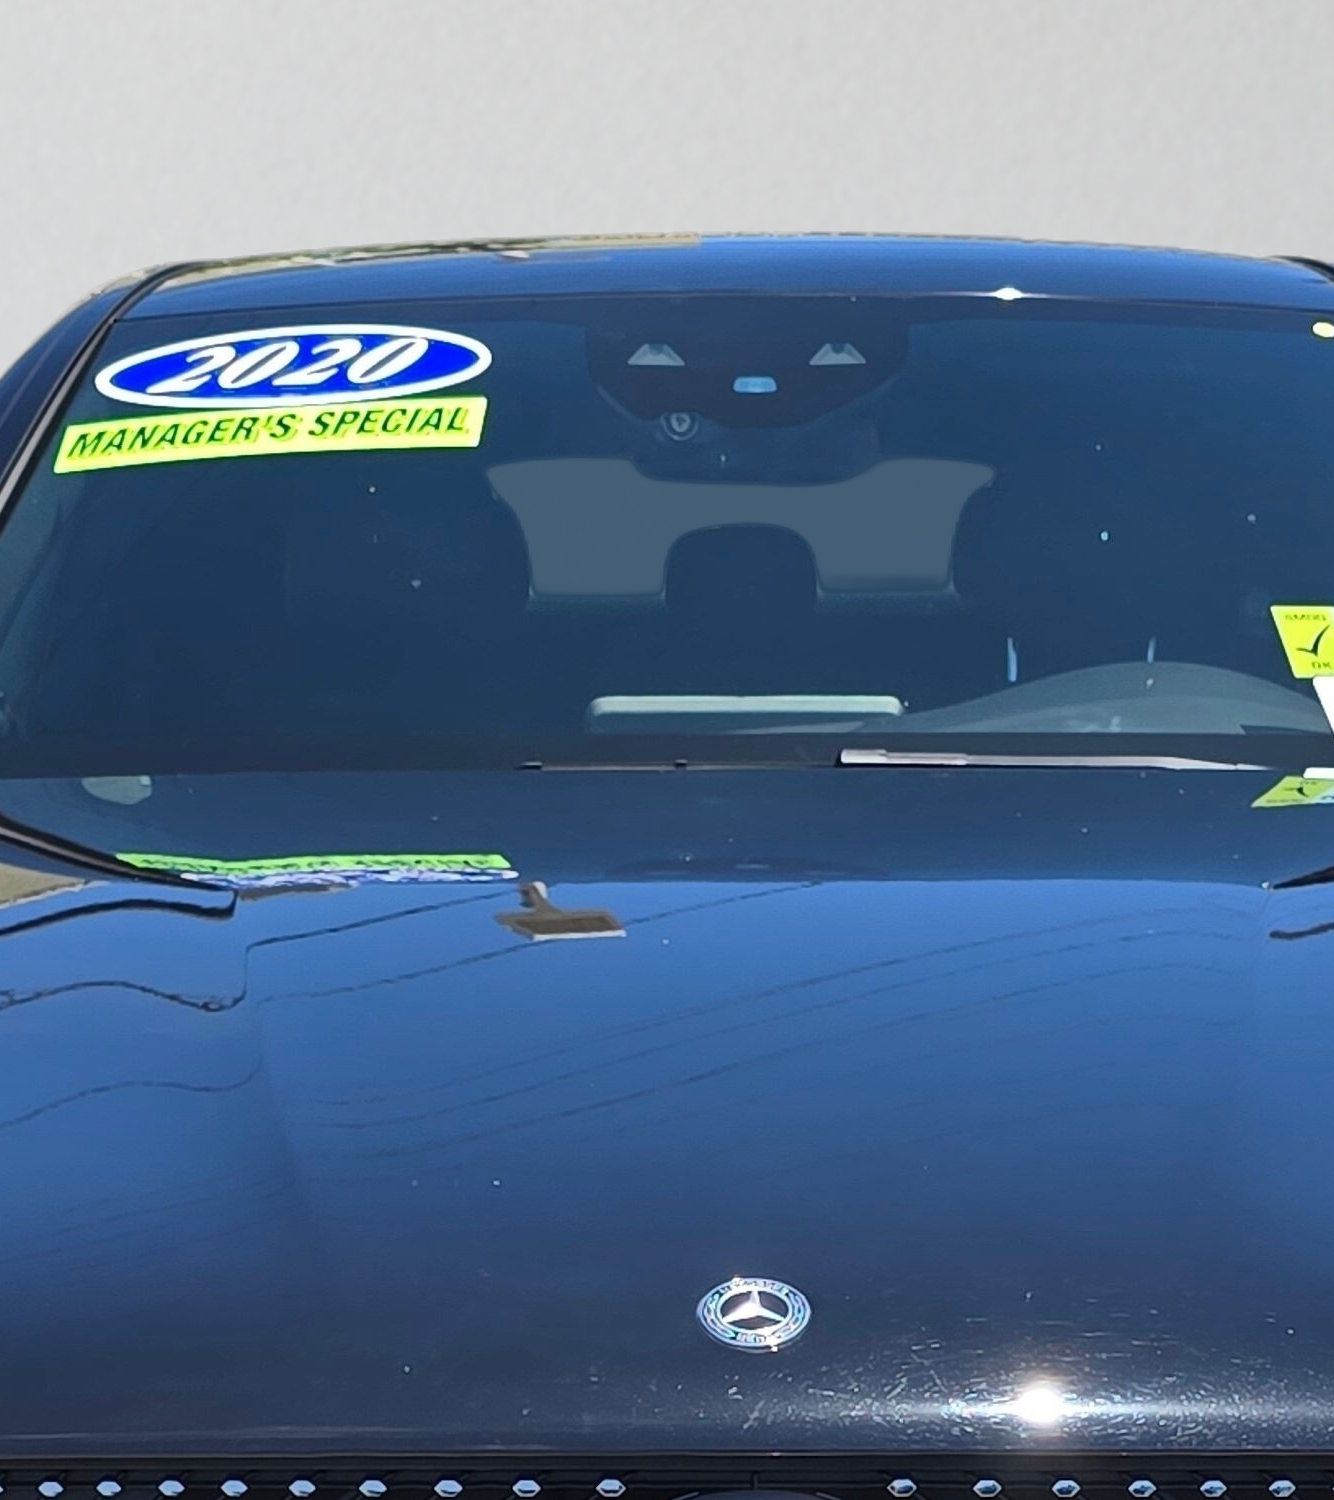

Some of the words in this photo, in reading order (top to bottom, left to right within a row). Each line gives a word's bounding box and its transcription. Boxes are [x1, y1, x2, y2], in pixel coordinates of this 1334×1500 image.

[146, 336, 429, 394] 2020
[67, 413, 299, 459] MANAGER'S
[307, 406, 470, 438] SPECIAL
